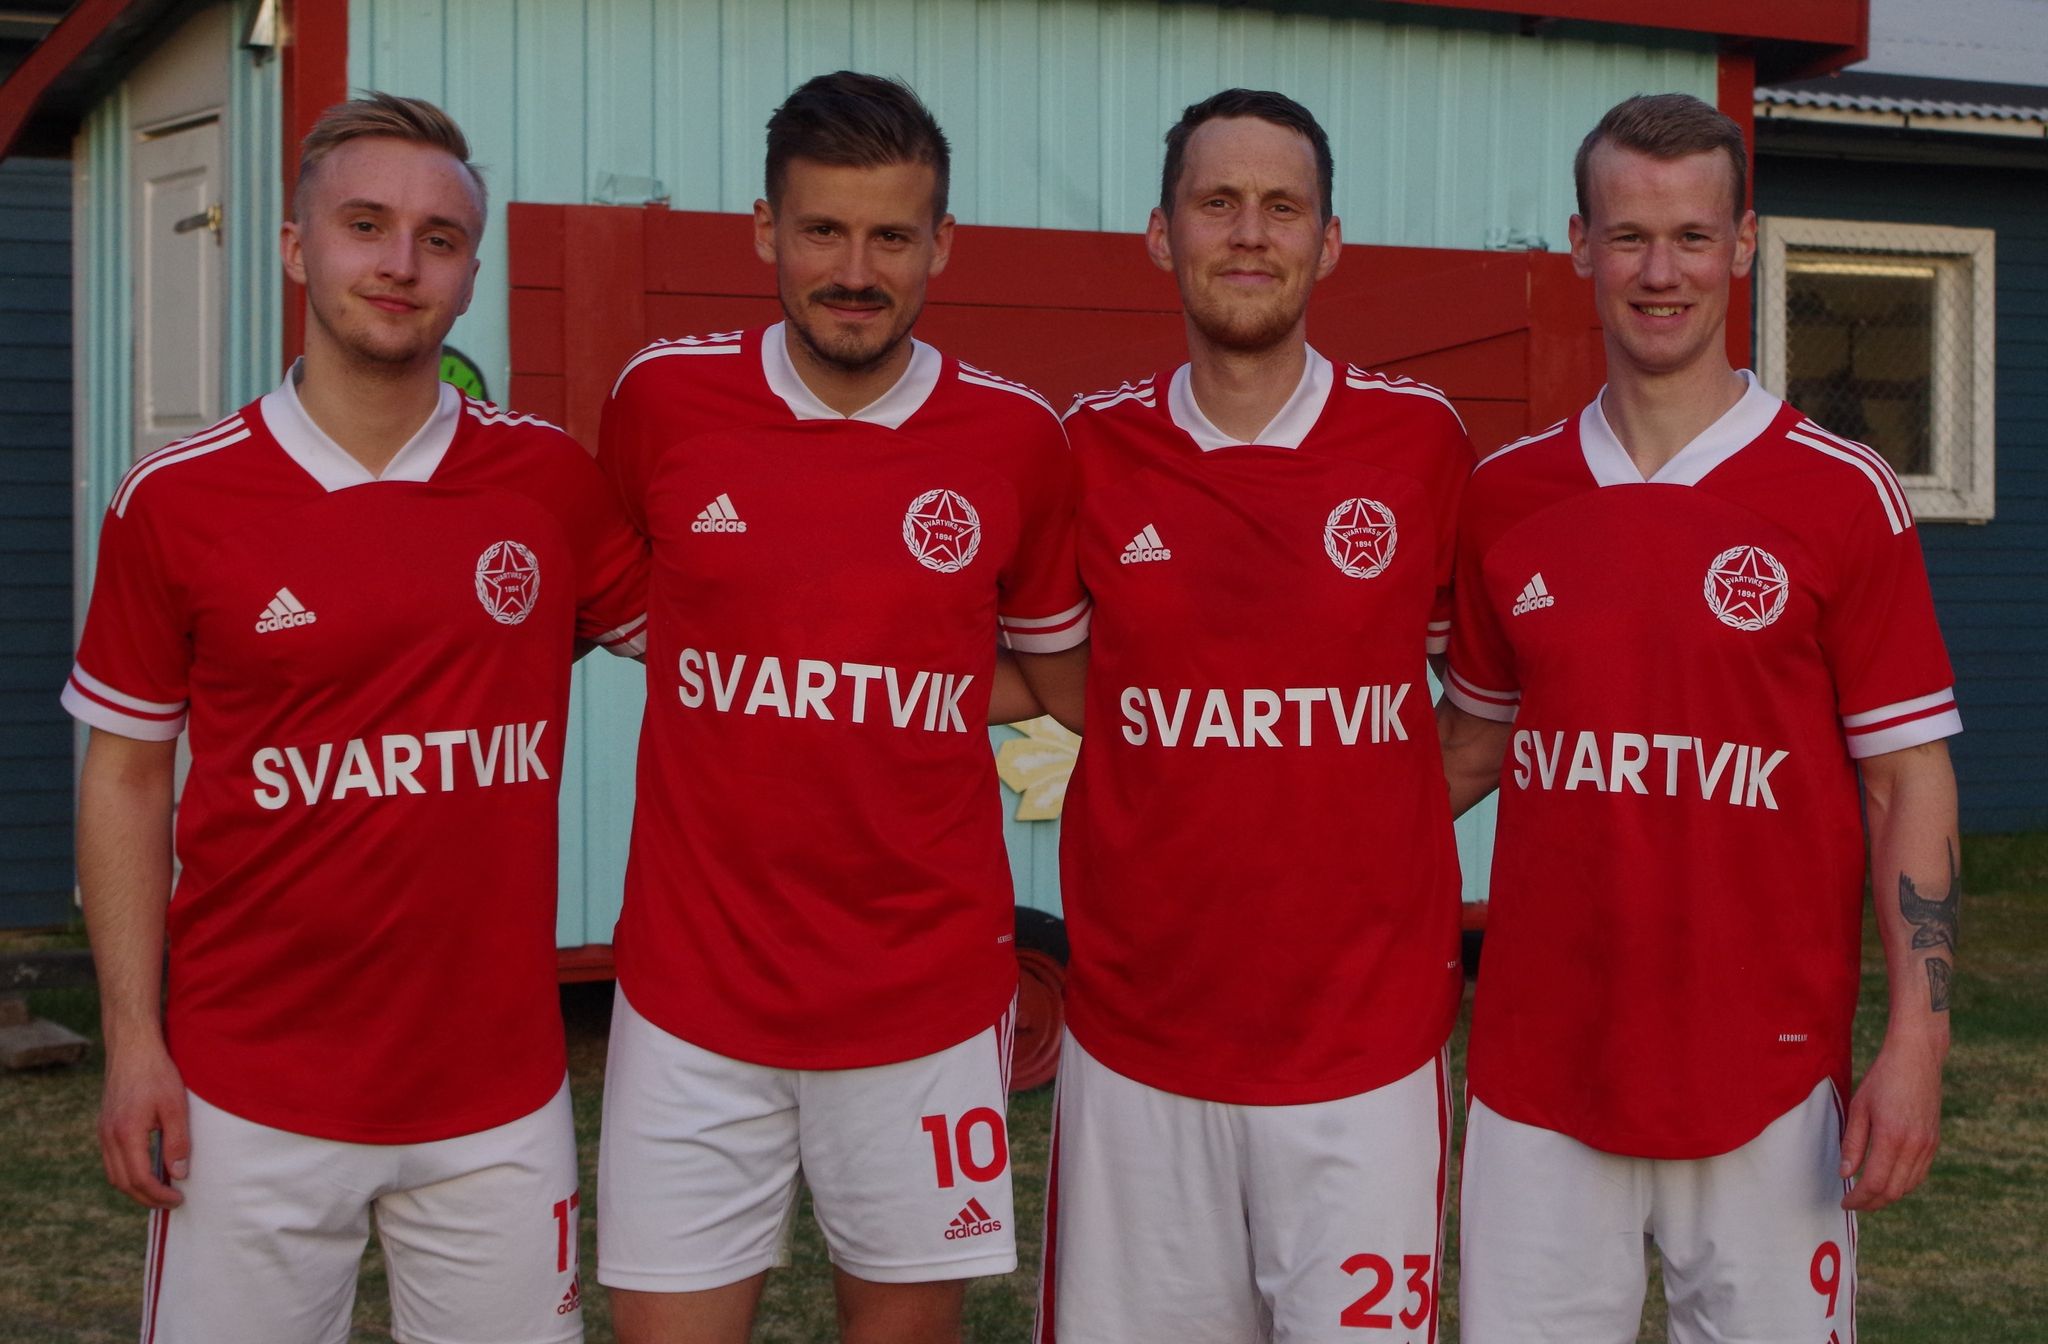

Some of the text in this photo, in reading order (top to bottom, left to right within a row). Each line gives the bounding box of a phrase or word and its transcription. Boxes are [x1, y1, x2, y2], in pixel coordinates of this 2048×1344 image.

[691, 517, 747, 533] adidas
[923, 518, 959, 530] SVARTVIKS
[1342, 527, 1377, 539] SVARTVIKS
[935, 532, 953, 542] 1894
[1355, 540, 1372, 548] 1894
[1120, 547, 1172, 565] adidas
[1725, 576, 1763, 588] SVARTVIKS
[1737, 589, 1756, 599] 1894
[1512, 595, 1555, 617] adidas
[255, 611, 317, 634] adidas
[678, 648, 975, 733] SVARTVIK
[1120, 684, 1412, 748] SVARTVIK
[252, 720, 550, 810] SVARTVIK
[1513, 730, 1790, 811] SVARTVIK
[921, 1107, 1008, 1189] 10
[944, 1219, 1002, 1240] adidas
[1809, 1240, 1841, 1319] 9
[1340, 1253, 1431, 1330] 23
